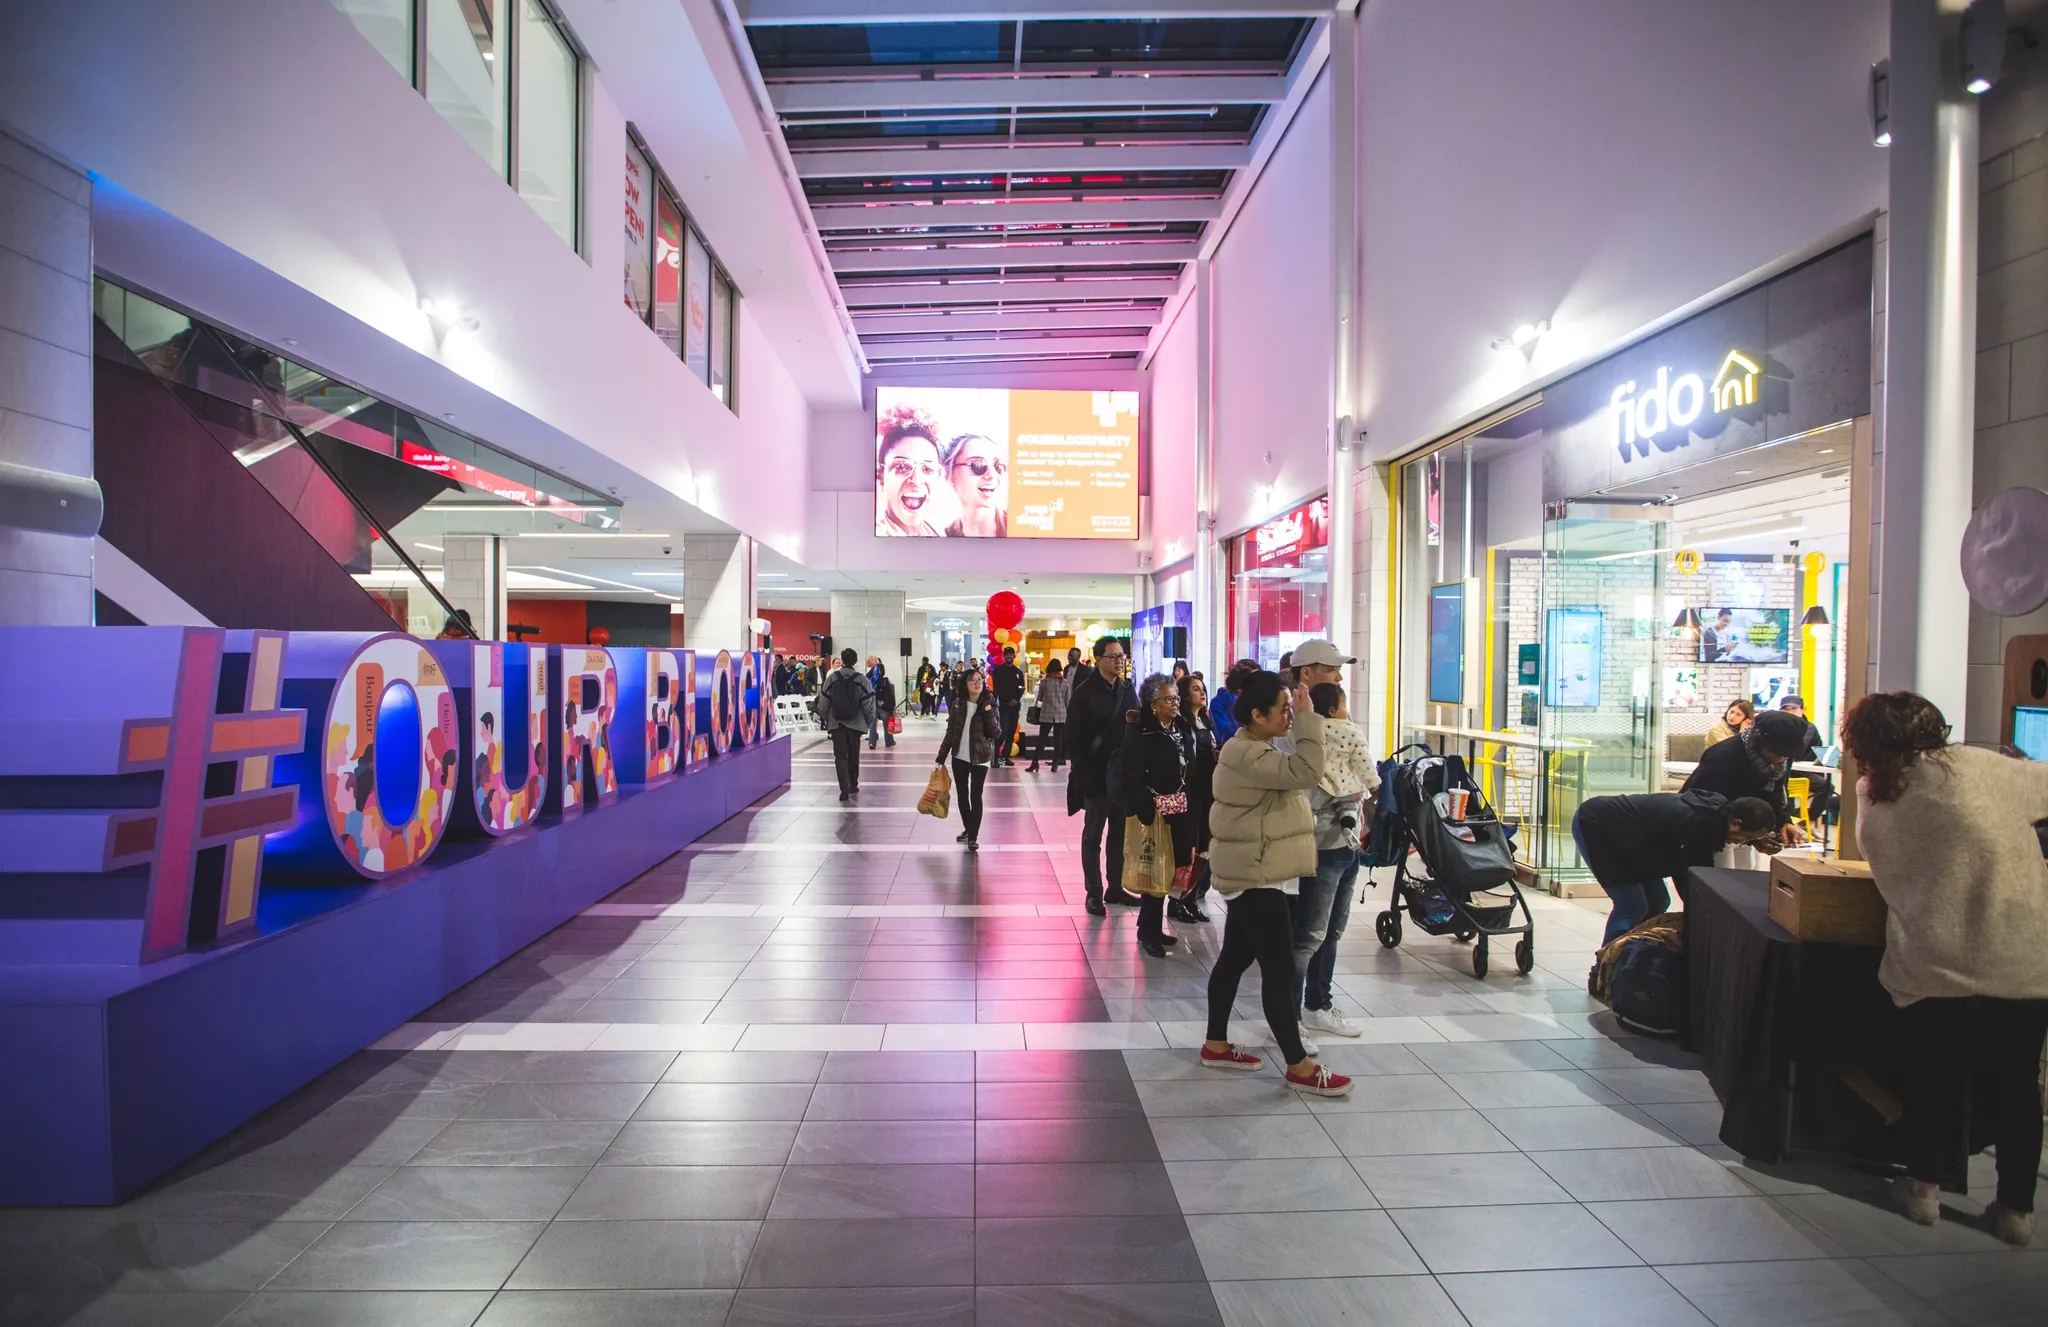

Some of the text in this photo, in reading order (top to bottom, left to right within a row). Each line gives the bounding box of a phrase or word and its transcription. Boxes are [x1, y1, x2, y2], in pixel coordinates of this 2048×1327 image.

[1609, 366, 1704, 448] fido
[364, 676, 375, 735] Bonjour
[645, 646, 776, 781] BLOCK
